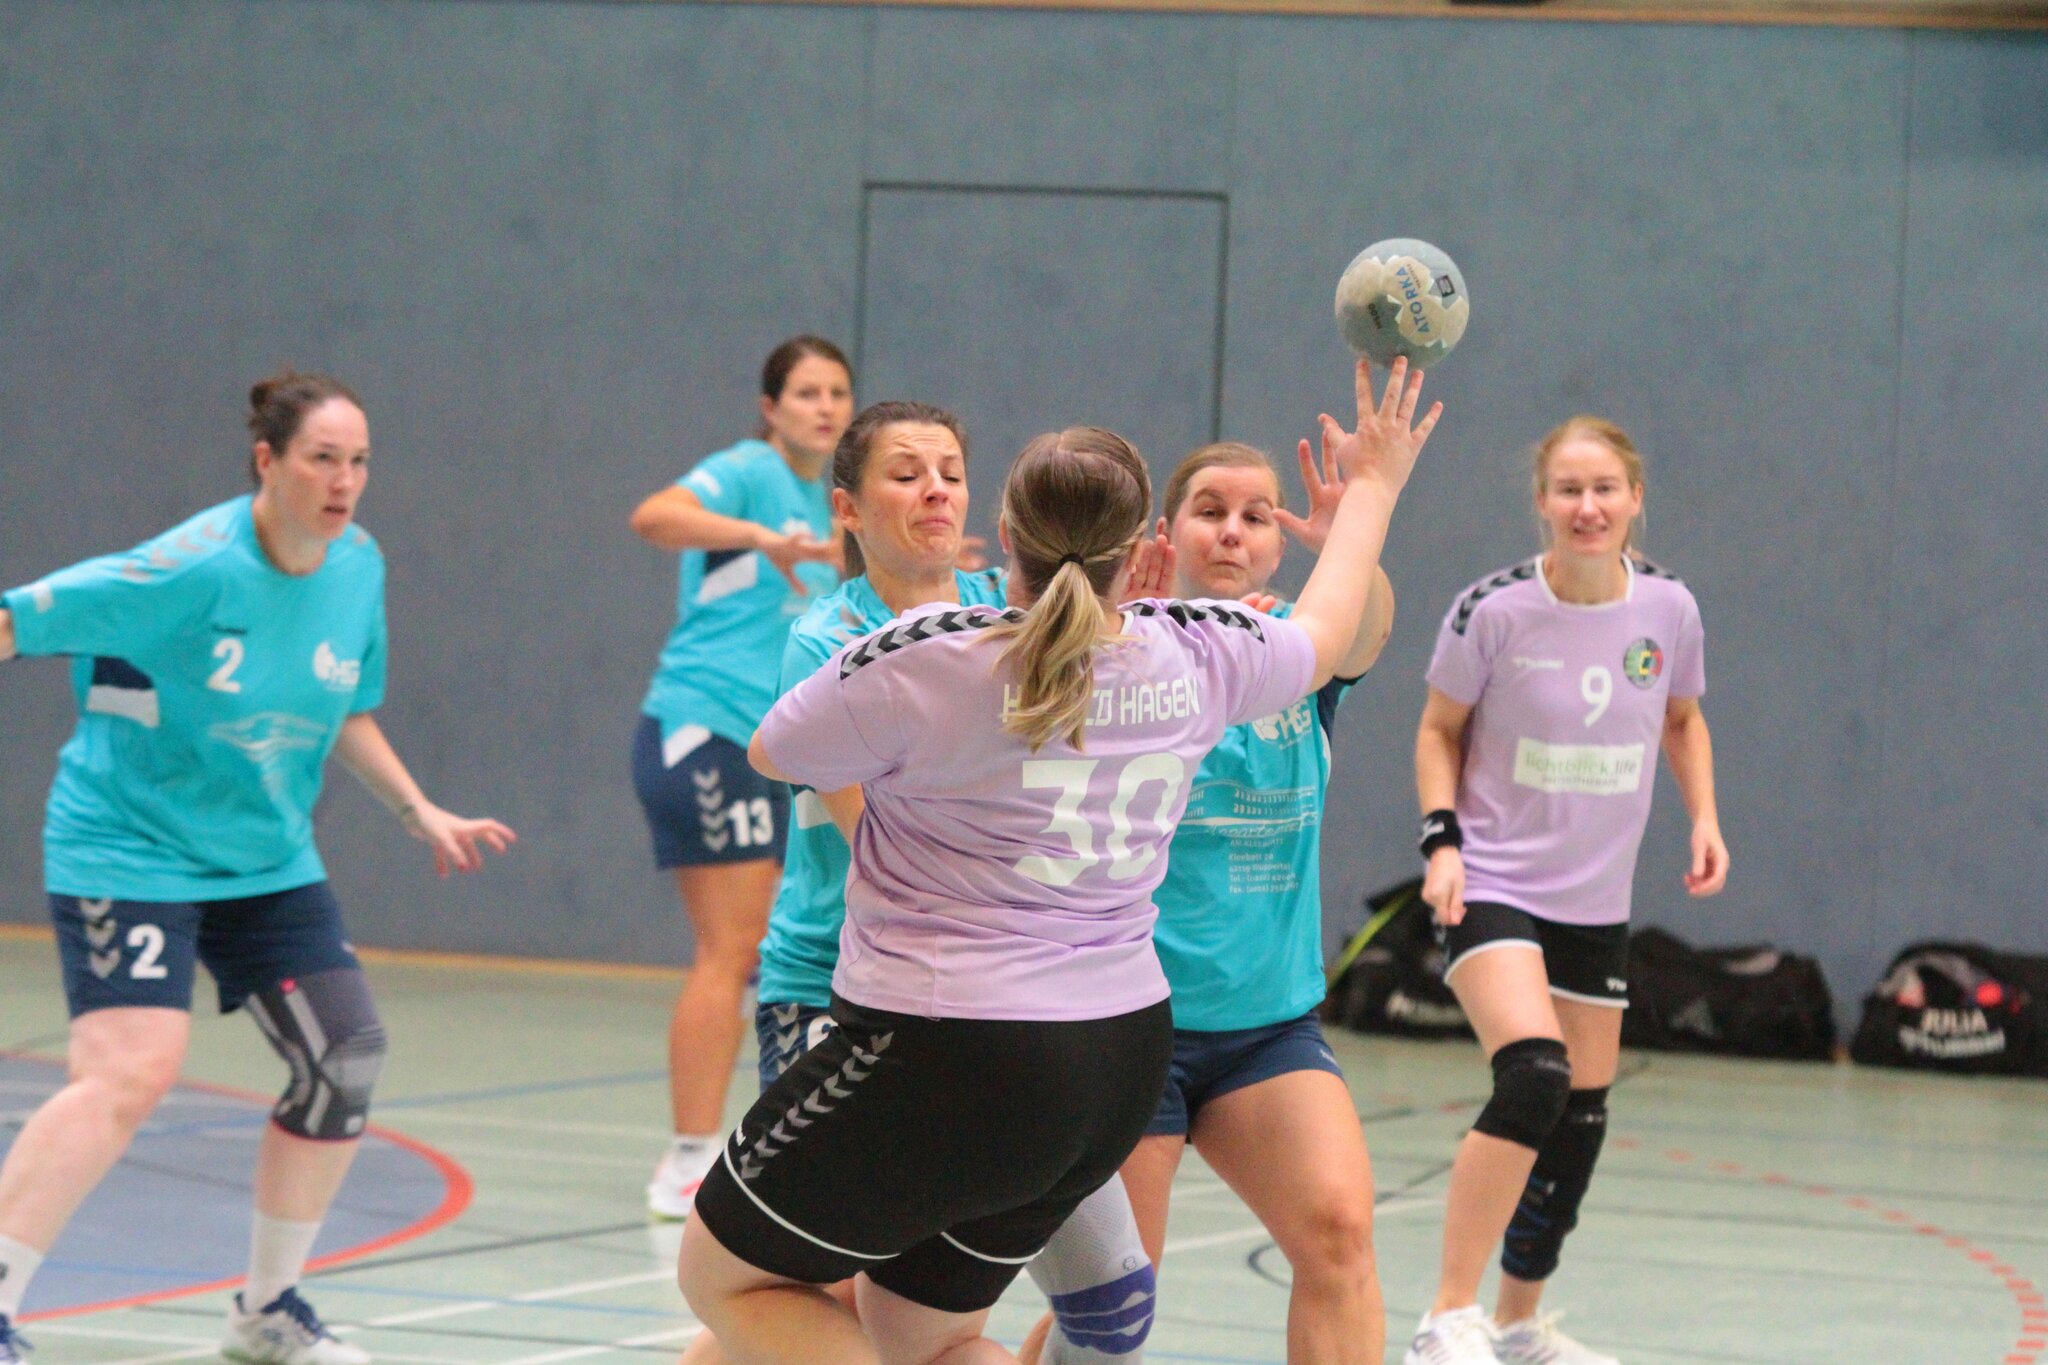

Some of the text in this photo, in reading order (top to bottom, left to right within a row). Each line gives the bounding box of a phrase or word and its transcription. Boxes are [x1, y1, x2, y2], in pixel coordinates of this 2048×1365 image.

[1396, 266, 1430, 334] ATORKA
[206, 638, 244, 693] 2
[1120, 676, 1201, 726] HAGEN
[1581, 665, 1612, 728] 9
[728, 797, 774, 847] 13
[1011, 751, 1185, 887] 30
[127, 923, 168, 979] 2
